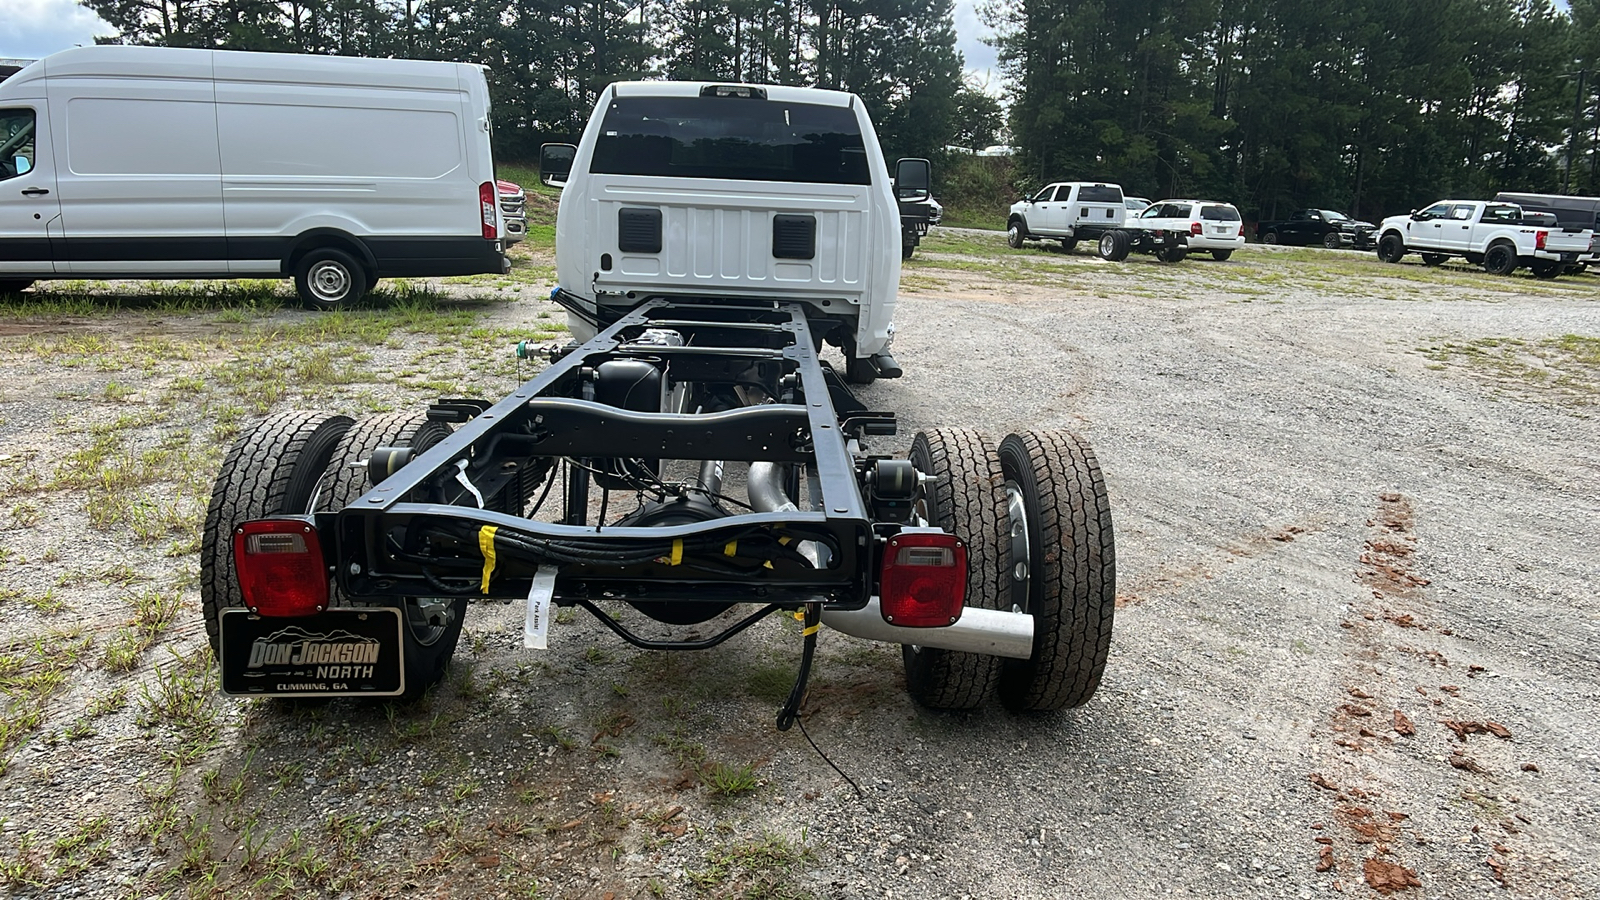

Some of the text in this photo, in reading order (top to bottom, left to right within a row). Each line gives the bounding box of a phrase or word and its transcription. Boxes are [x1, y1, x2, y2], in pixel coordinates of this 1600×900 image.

[247, 641, 381, 668] DON JACKSON
[316, 666, 374, 679] NORTH
[276, 682, 348, 691] CUMMING, GA
